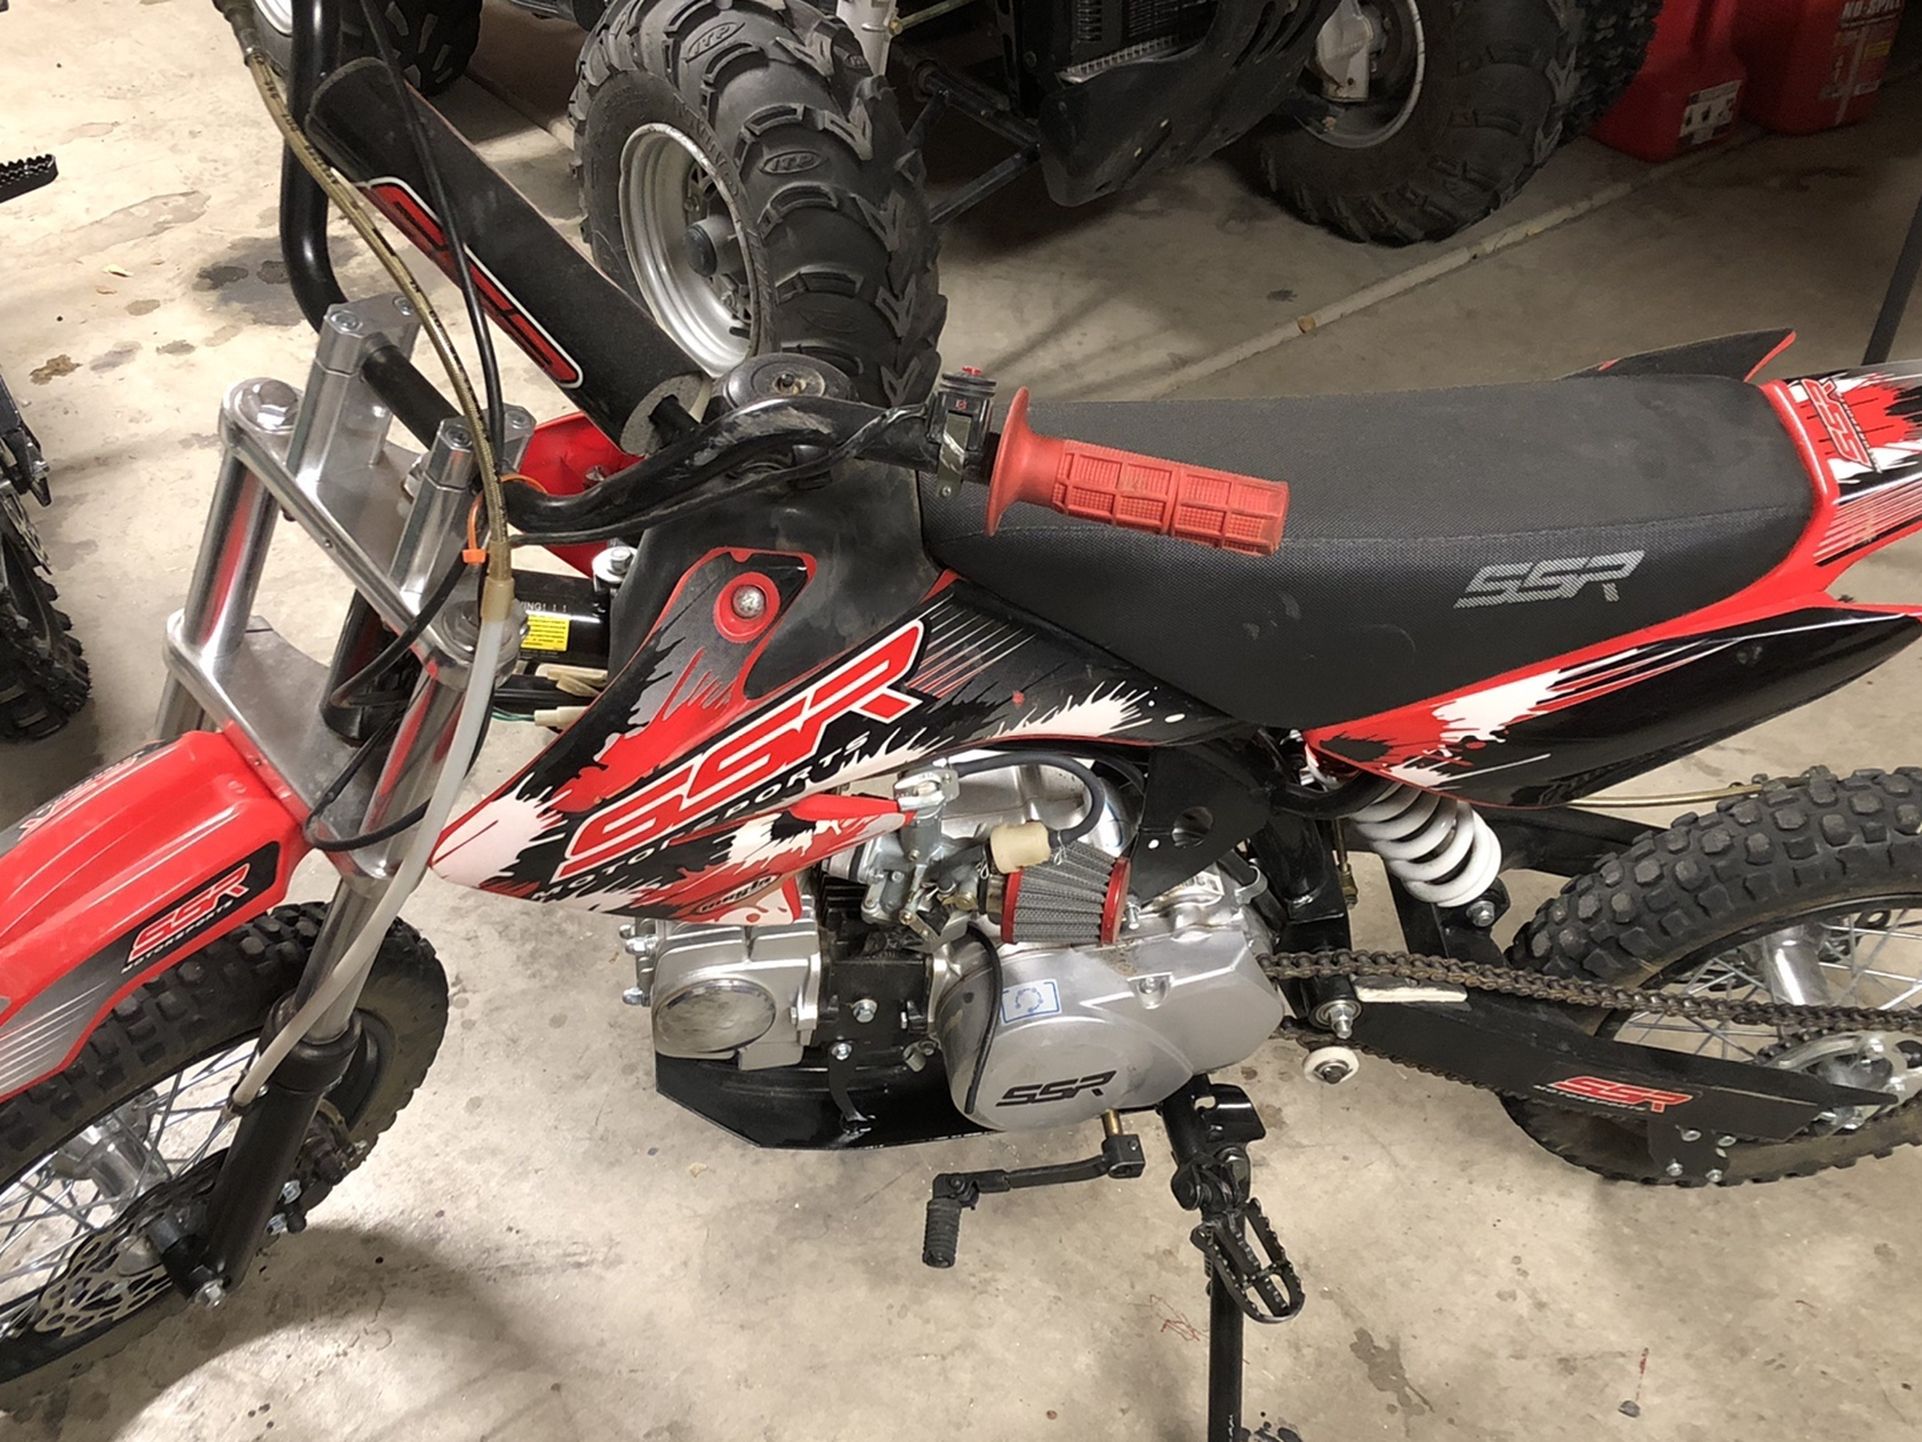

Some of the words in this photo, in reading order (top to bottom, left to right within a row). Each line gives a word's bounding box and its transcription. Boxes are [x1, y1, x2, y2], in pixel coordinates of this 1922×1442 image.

[770, 154, 816, 172] ITP
[1453, 550, 1645, 608] SSR
[549, 618, 924, 884] SSR
[127, 862, 250, 963] SSR
[995, 1070, 1117, 1107] SSR
[1548, 1075, 1694, 1113] SSR
